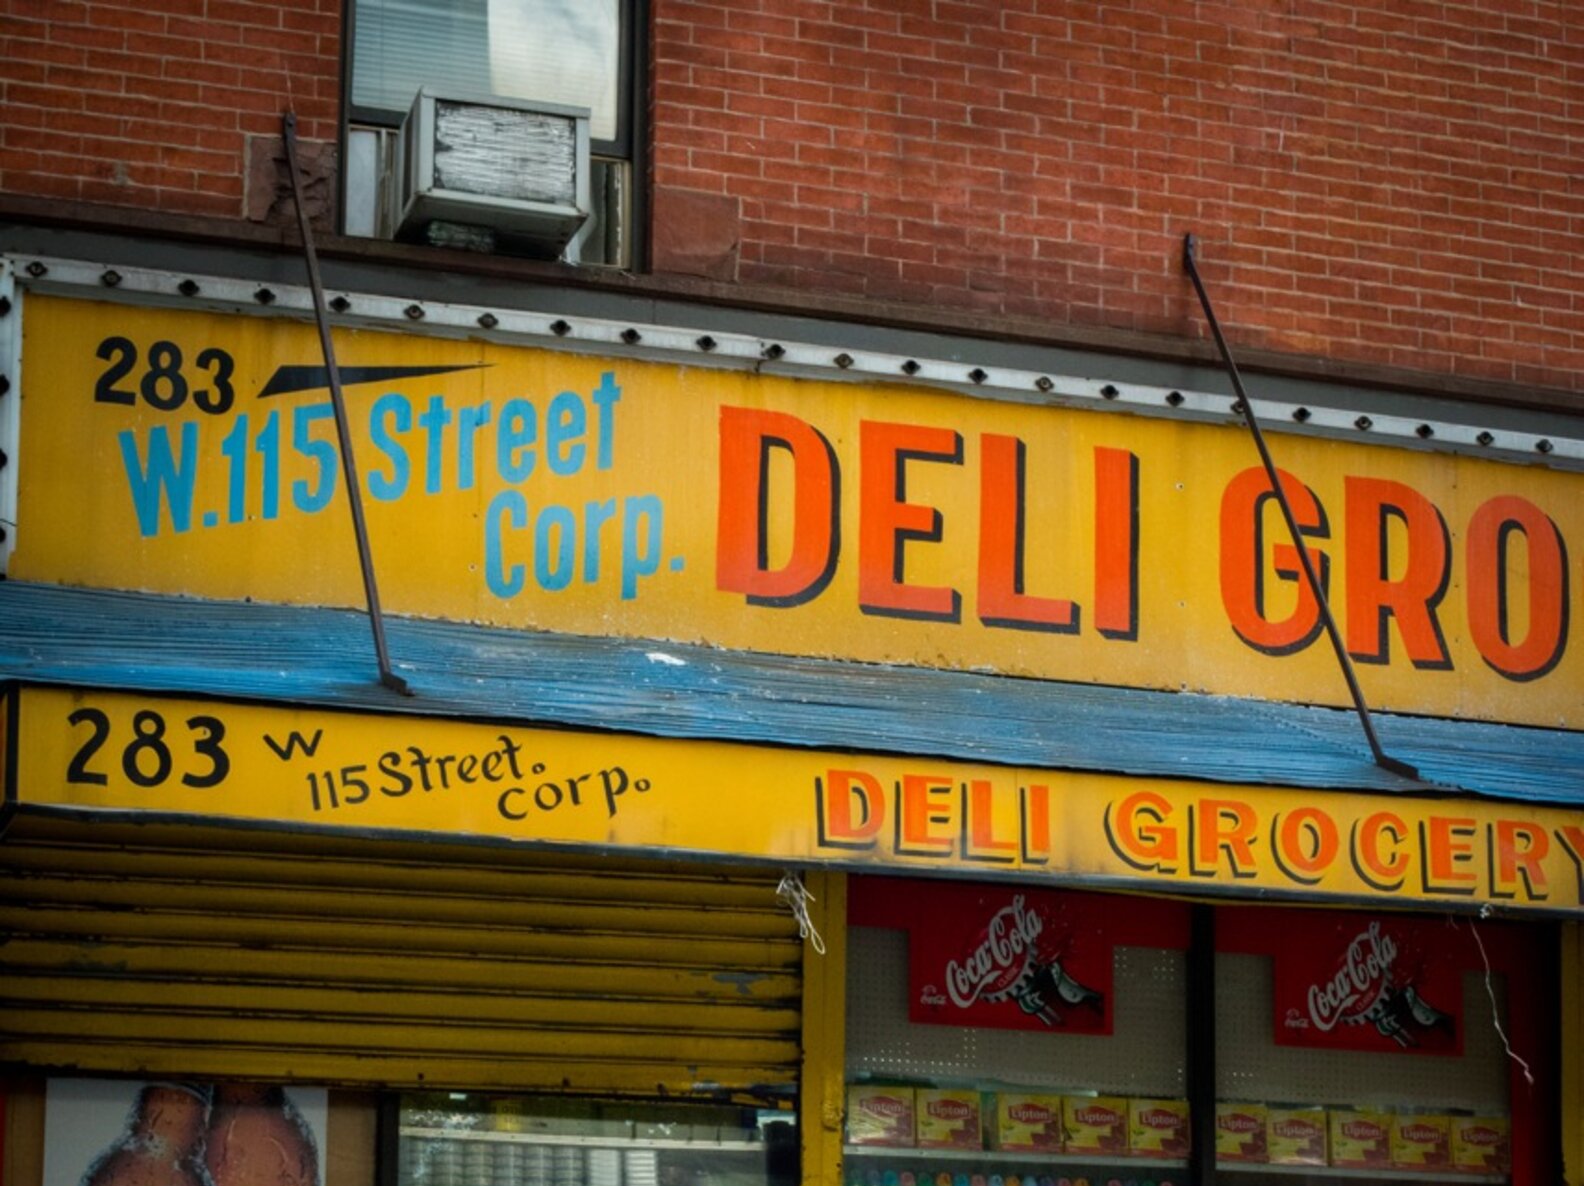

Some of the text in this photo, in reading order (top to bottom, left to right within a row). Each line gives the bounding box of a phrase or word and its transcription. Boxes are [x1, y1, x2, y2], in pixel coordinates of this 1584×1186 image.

[94, 336, 235, 415] 283
[367, 372, 622, 501] Street
[485, 490, 685, 600] Corp.
[715, 405, 1569, 683] DELI GRO
[66, 708, 230, 788] 283
[306, 766, 371, 811] 115
[815, 769, 1051, 865] DELI
[930, 1104, 969, 1119] Lipton
[1011, 1108, 1049, 1123] Lipton
[1078, 1112, 1116, 1127] Lipton
[1141, 1114, 1179, 1130] Lipton
[1220, 1116, 1258, 1132] Lipton
[1276, 1122, 1316, 1139] Lipton
[1343, 1124, 1381, 1140] Lipton
[1402, 1127, 1440, 1143] Lipton
